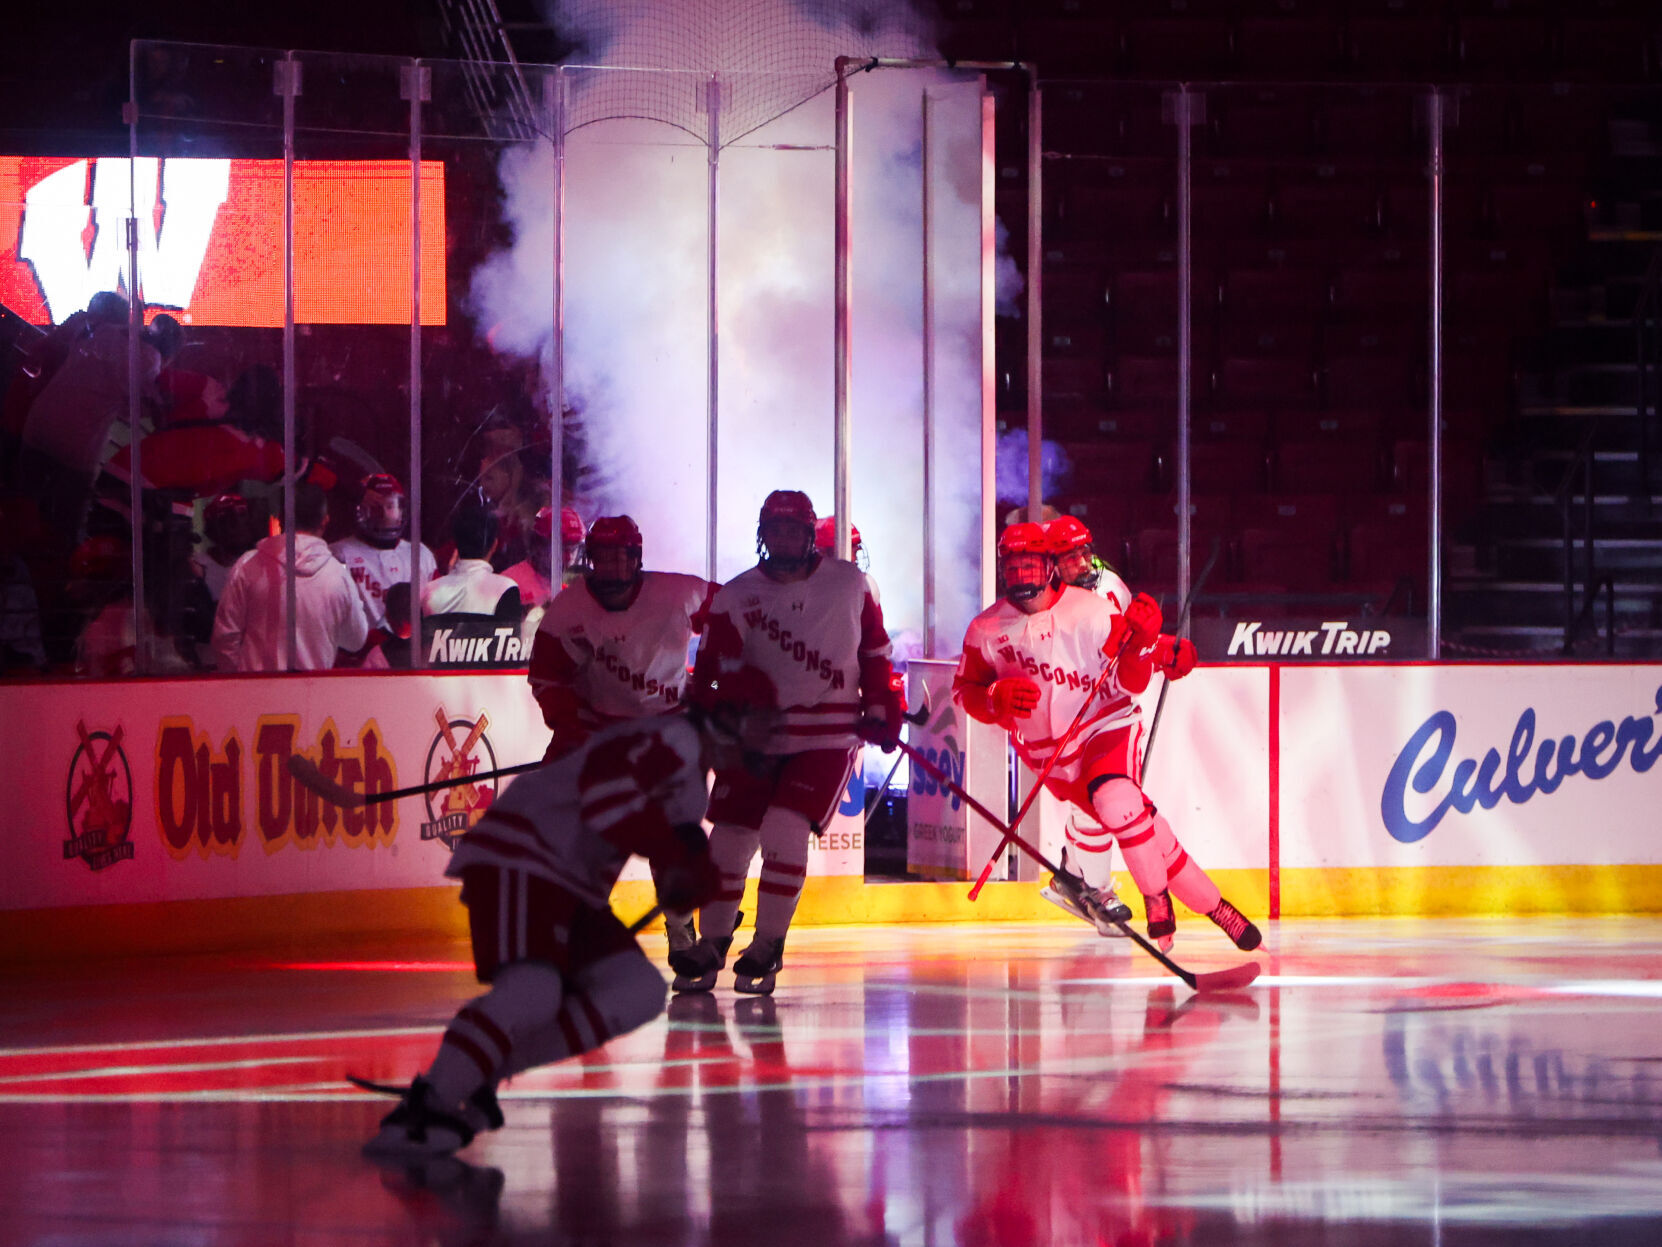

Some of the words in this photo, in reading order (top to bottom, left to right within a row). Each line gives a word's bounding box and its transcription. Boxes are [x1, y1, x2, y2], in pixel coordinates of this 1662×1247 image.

[428, 628, 493, 662] KWIK
[1227, 622, 1318, 655] KWIK
[1321, 621, 1391, 655] TRIP
[157, 722, 244, 853] Old
[255, 720, 397, 847] Dutch
[808, 833, 862, 851] HEESE
